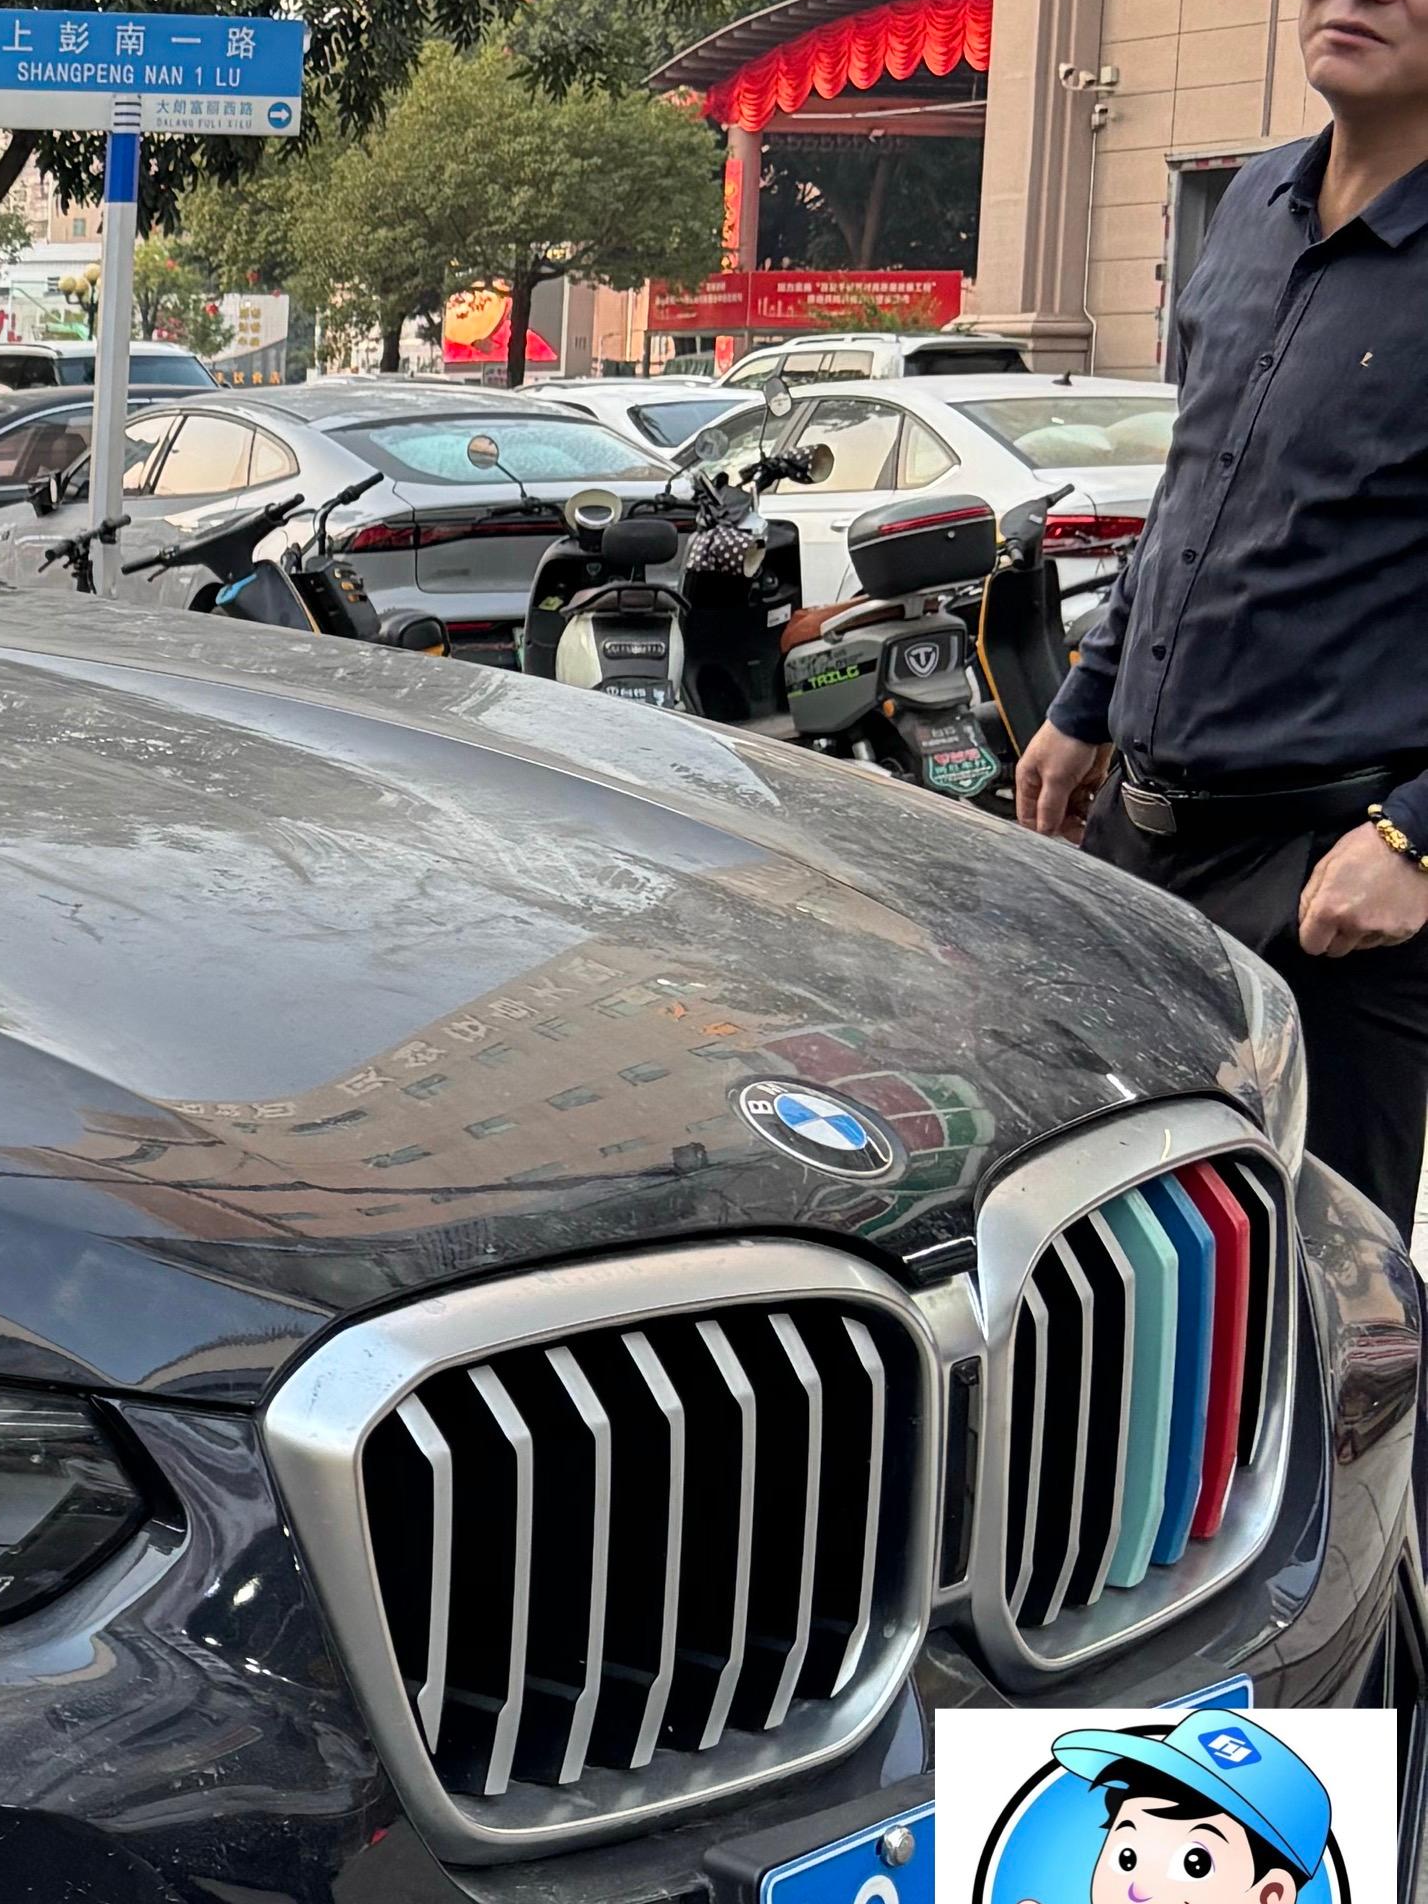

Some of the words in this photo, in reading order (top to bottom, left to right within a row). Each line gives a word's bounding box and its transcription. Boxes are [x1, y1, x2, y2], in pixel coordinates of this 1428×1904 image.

[2, 19, 257, 60] 上彭南一路
[16, 63, 135, 85] SHANGPENG
[144, 65, 184, 86] NAN
[194, 67, 203, 86] 1
[214, 67, 242, 88] LU
